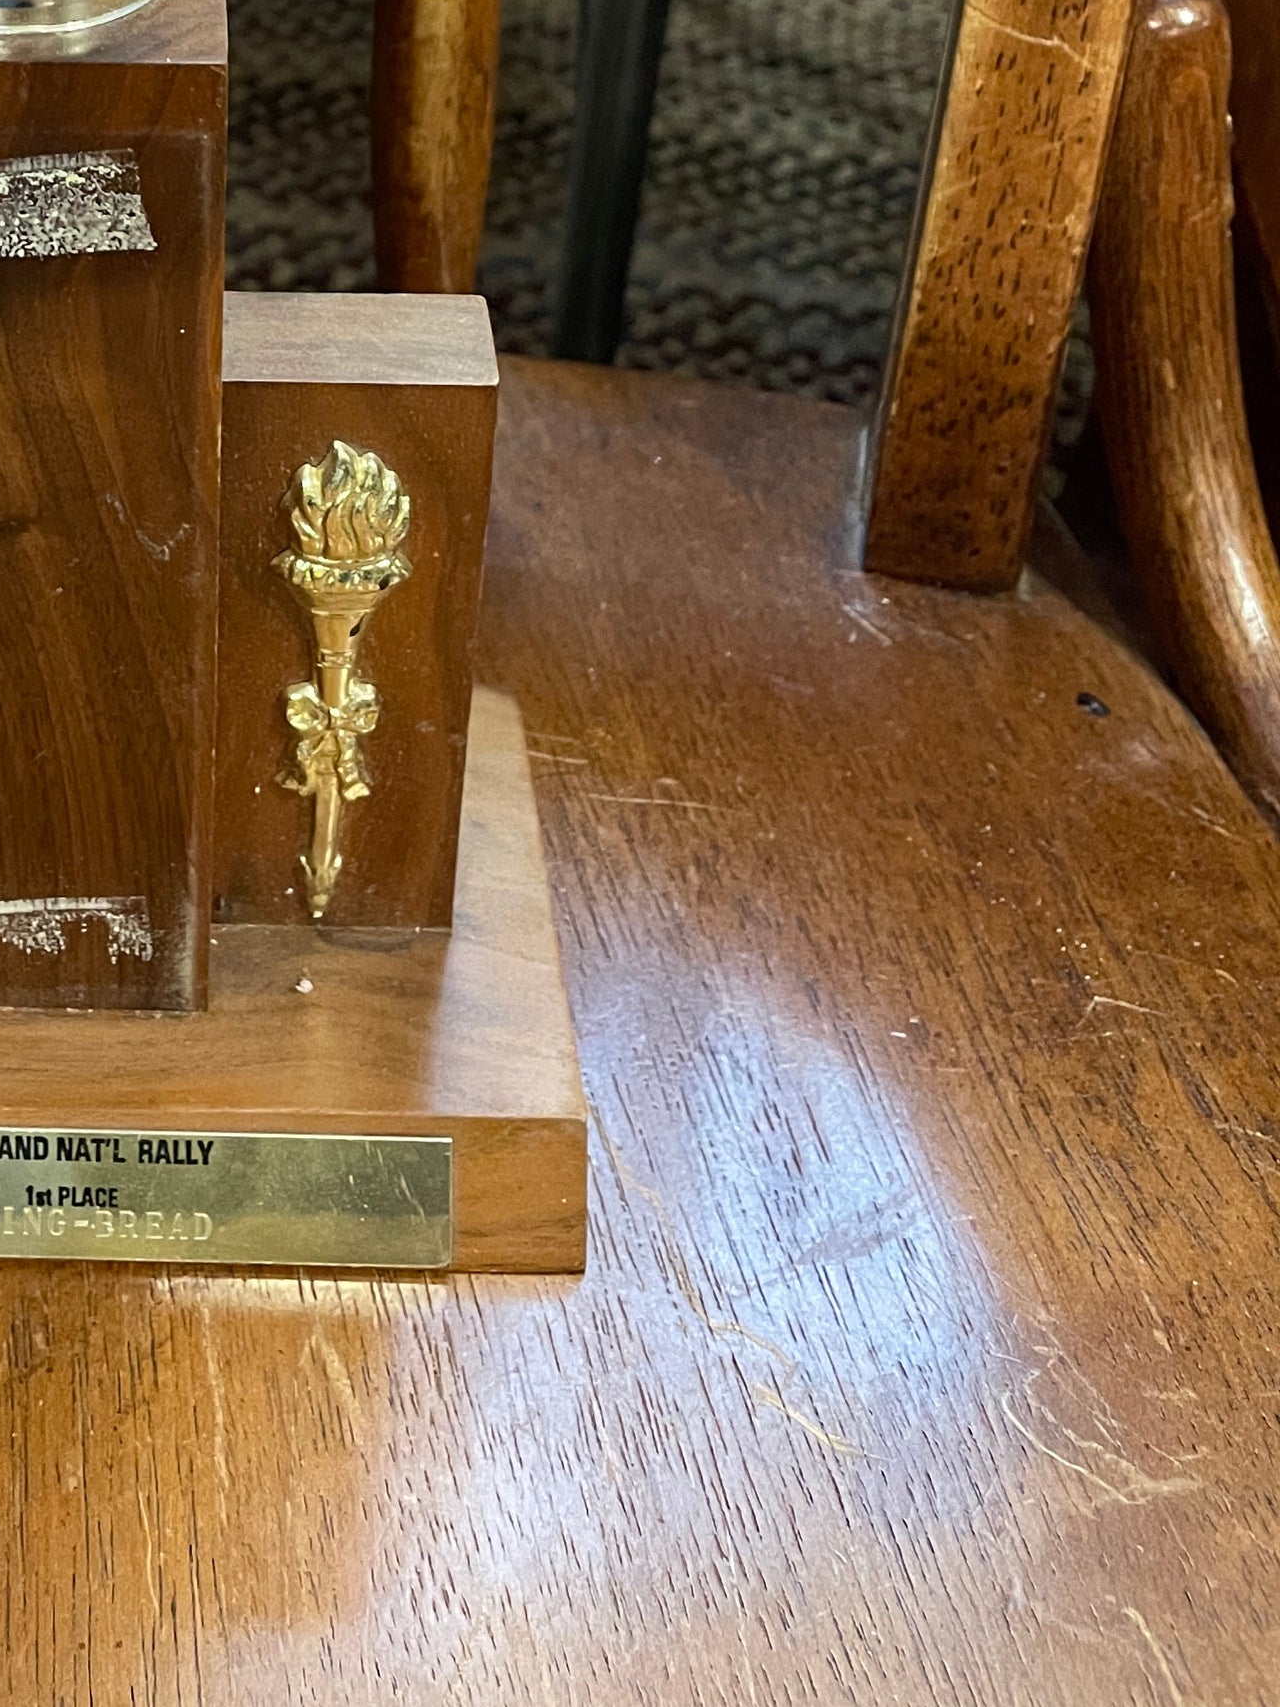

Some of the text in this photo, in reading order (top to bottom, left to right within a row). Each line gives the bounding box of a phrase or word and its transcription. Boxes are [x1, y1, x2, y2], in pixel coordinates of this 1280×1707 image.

[56, 1136, 127, 1164] NAT'L
[138, 1138, 214, 1166] RALLY
[25, 1185, 119, 1208] 1st PLACE
